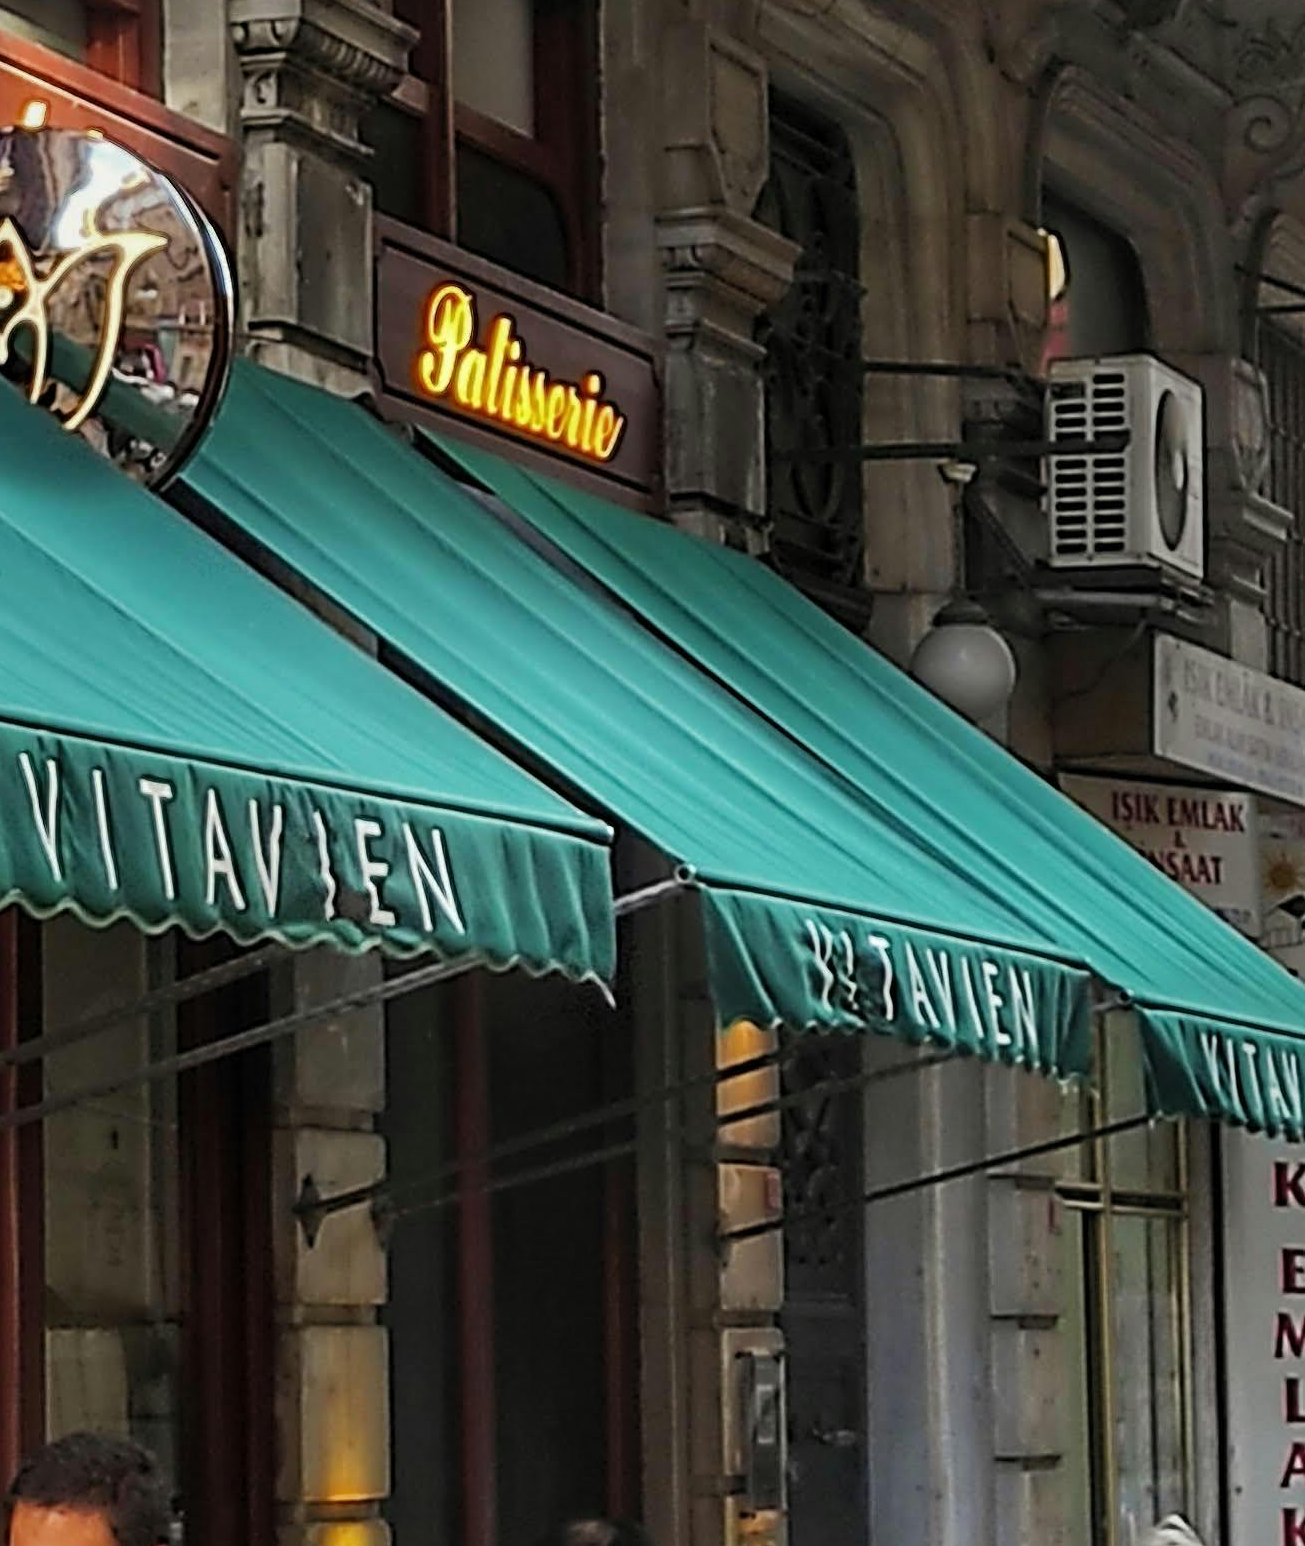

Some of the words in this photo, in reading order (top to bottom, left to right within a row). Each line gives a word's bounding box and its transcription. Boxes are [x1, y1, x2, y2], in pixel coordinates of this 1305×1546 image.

[19, 752, 465, 934] VITAVIEN
[1166, 796, 1245, 833] EMLAK
[805, 918, 1038, 1055] VITAVIEN
